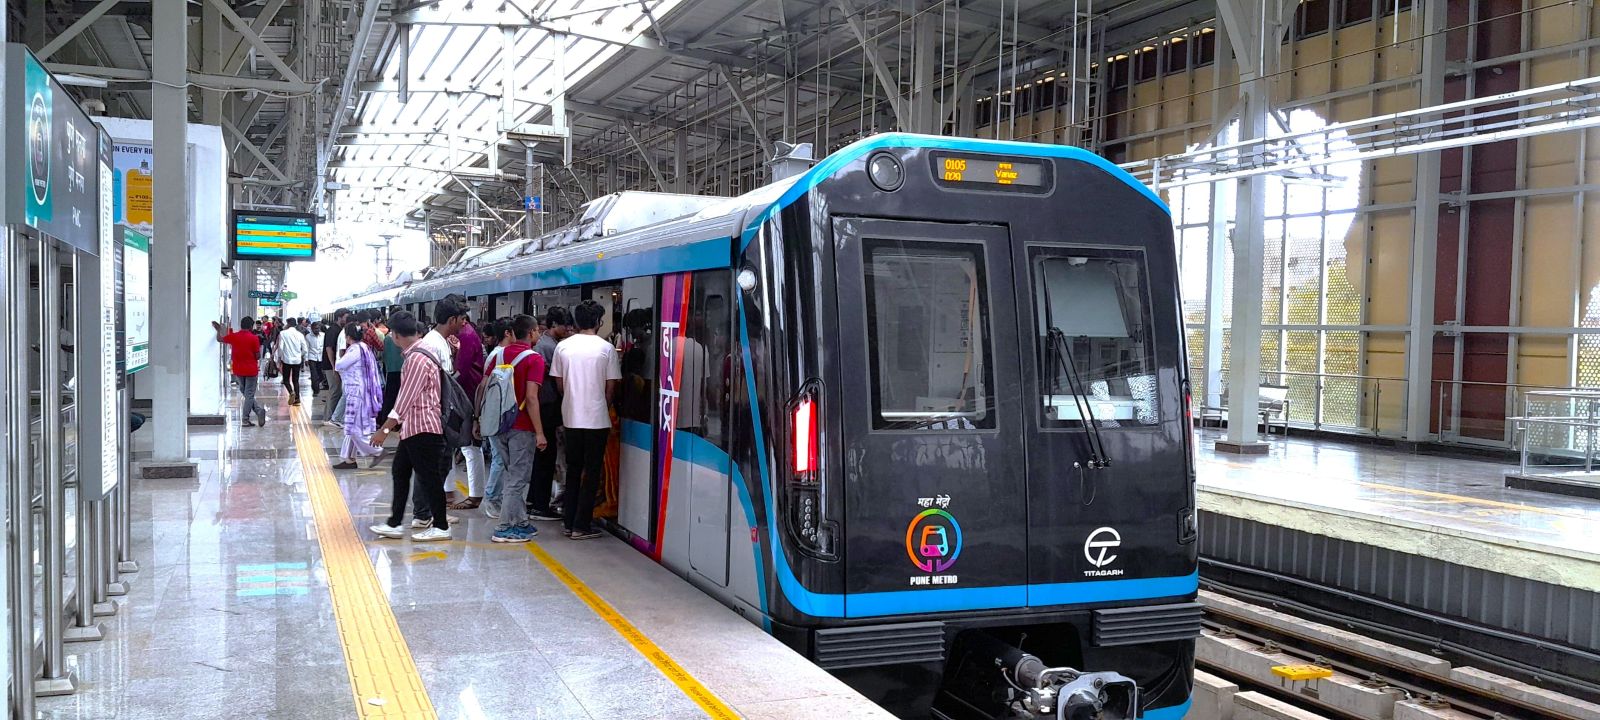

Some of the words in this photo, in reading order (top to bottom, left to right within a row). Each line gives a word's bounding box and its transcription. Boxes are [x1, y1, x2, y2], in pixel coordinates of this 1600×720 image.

[121, 146, 142, 155] EVERY
[945, 159, 966, 171] 0105
[995, 169, 1018, 179] Vanaz
[72, 206, 82, 228] PMC
[917, 497, 933, 507] महा
[935, 494, 951, 508] मेट्रो
[1084, 569, 1124, 577] TITAGARH
[910, 576, 931, 586] PUNE
[931, 575, 958, 585] METRO
